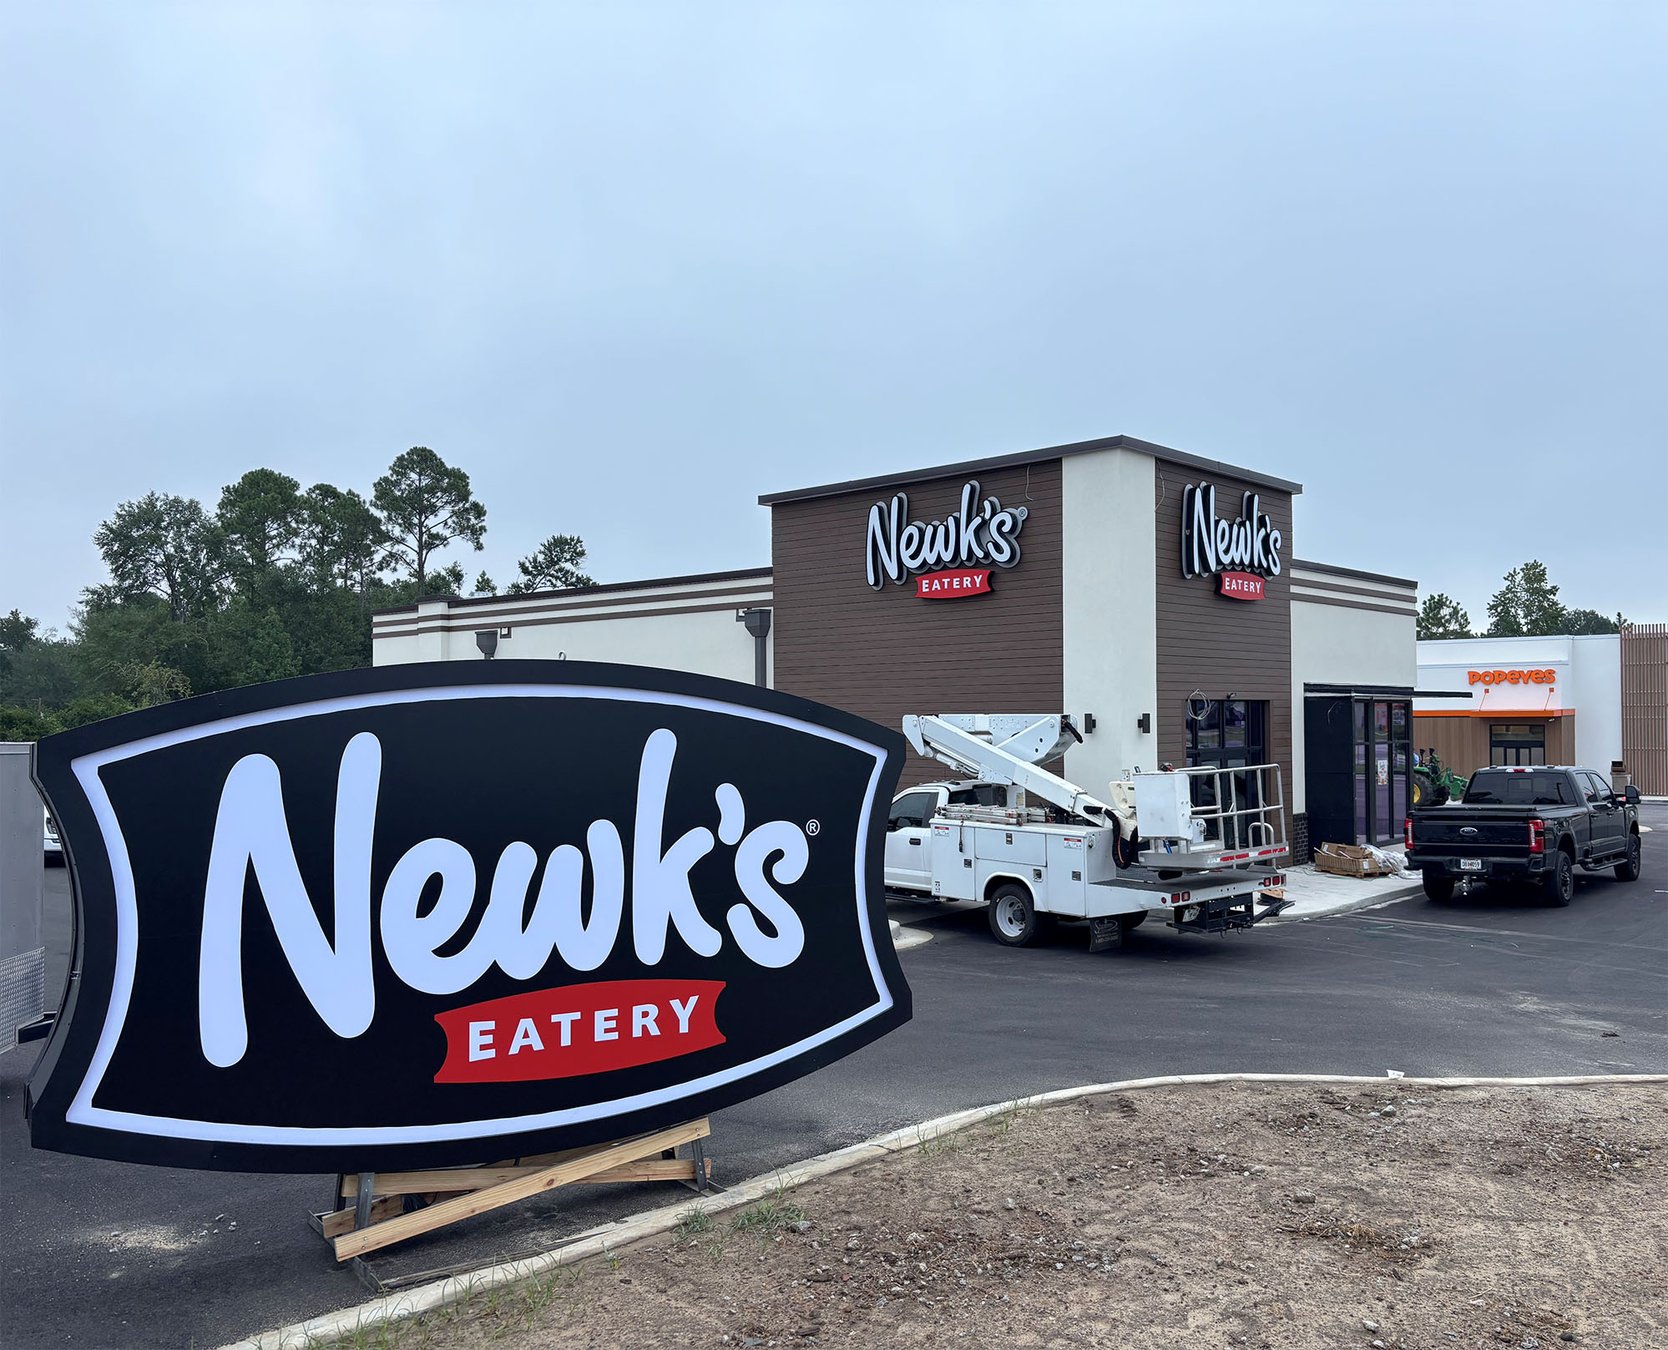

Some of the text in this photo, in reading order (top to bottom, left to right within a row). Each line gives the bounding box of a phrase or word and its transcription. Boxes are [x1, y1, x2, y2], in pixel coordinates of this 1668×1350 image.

[866, 482, 1013, 587] Newk's
[1192, 484, 1283, 577] Newk's
[922, 574, 983, 593] EATERY
[1224, 577, 1262, 594] EATERY
[199, 728, 809, 1068] Newk's
[468, 994, 700, 1063] EATERY
